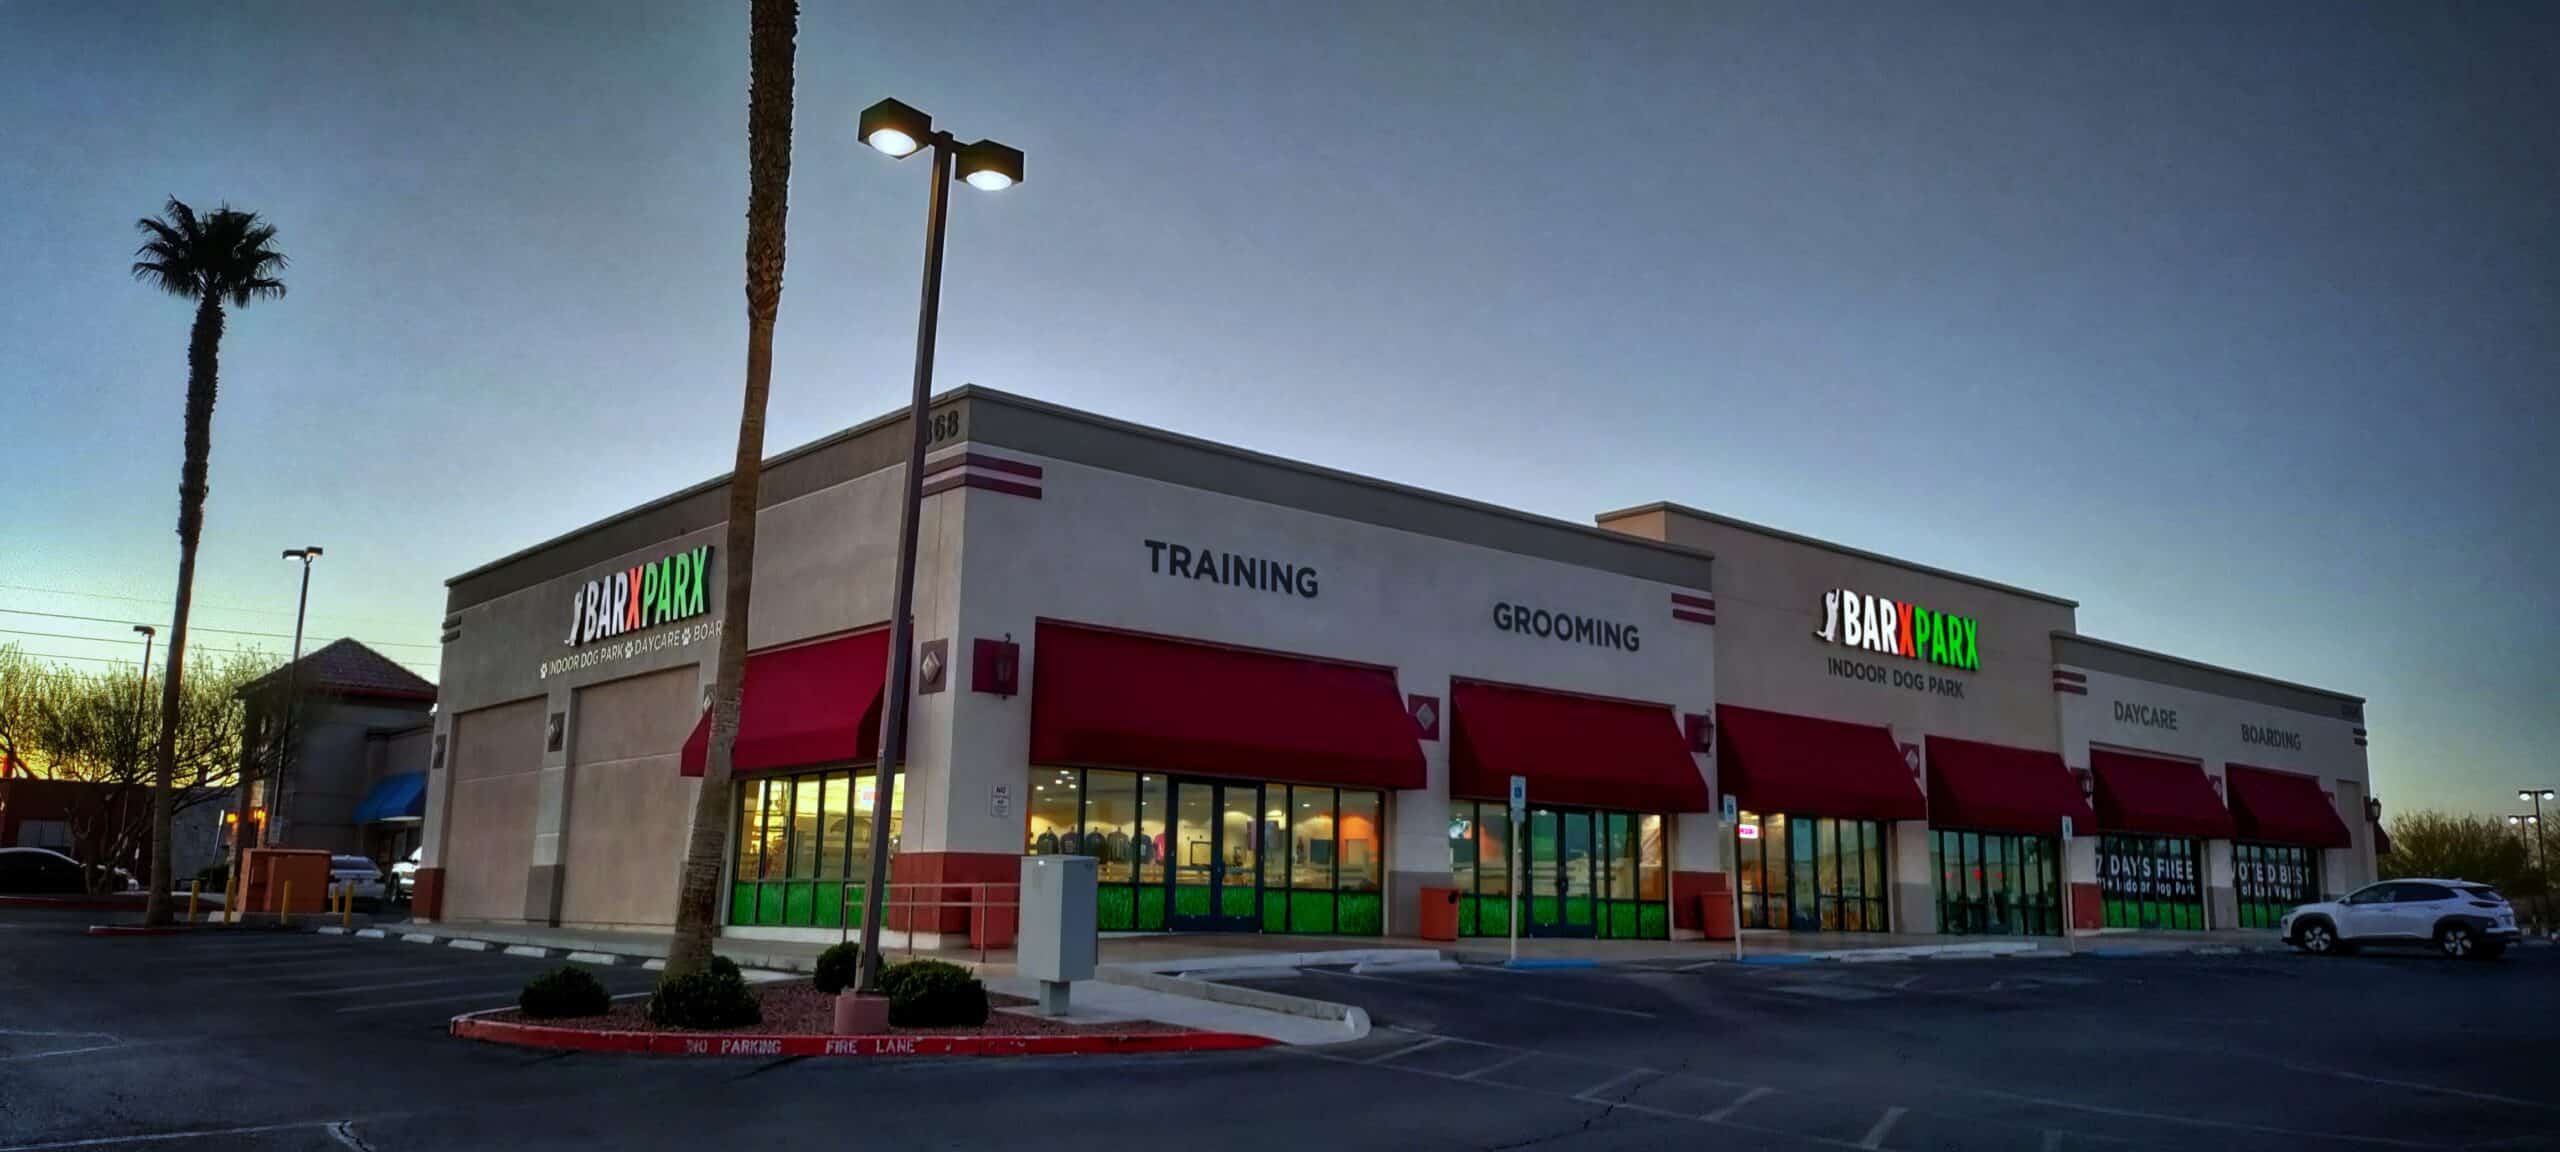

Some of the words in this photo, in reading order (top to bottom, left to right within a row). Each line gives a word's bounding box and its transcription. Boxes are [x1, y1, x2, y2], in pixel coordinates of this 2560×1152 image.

[1145, 538, 1319, 599] TRAINING
[583, 544, 711, 643] BARXPARX
[1493, 602, 1640, 653] GROOMING
[1843, 589, 1981, 671] BARXPARX
[549, 655, 579, 676] INDOOR
[580, 649, 599, 669] DOG
[600, 643, 624, 664] PARK
[634, 630, 680, 655] DAYCARE
[1828, 657, 1887, 685] INDOOR
[1893, 670, 1925, 691] DOG
[1929, 676, 1965, 699] PARK
[2114, 700, 2177, 730] DAYCARE
[2241, 723, 2302, 750] BOARDING
[2110, 854, 2152, 877] DAYS
[686, 1039, 709, 1053] NO
[721, 1039, 782, 1054] PARKING
[825, 1040, 857, 1054] FIRE
[876, 1040, 915, 1053] LANE
